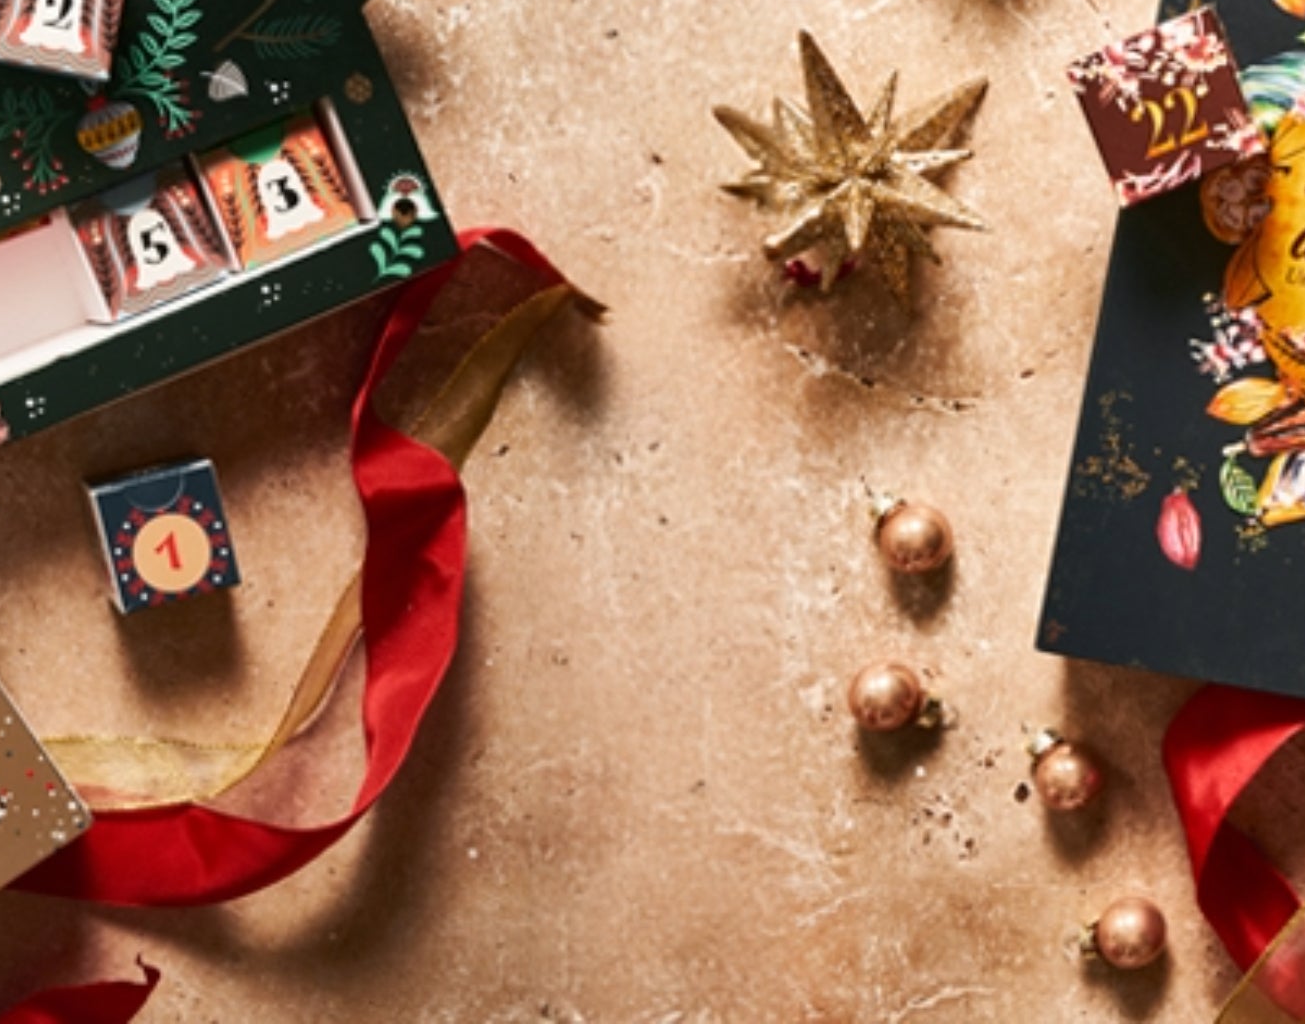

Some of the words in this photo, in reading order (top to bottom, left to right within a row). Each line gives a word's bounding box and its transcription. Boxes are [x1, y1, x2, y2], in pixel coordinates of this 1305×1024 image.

[1130, 86, 1209, 159] 22
[267, 173, 301, 215] 3
[140, 222, 170, 266] 5
[154, 531, 183, 573] 1
